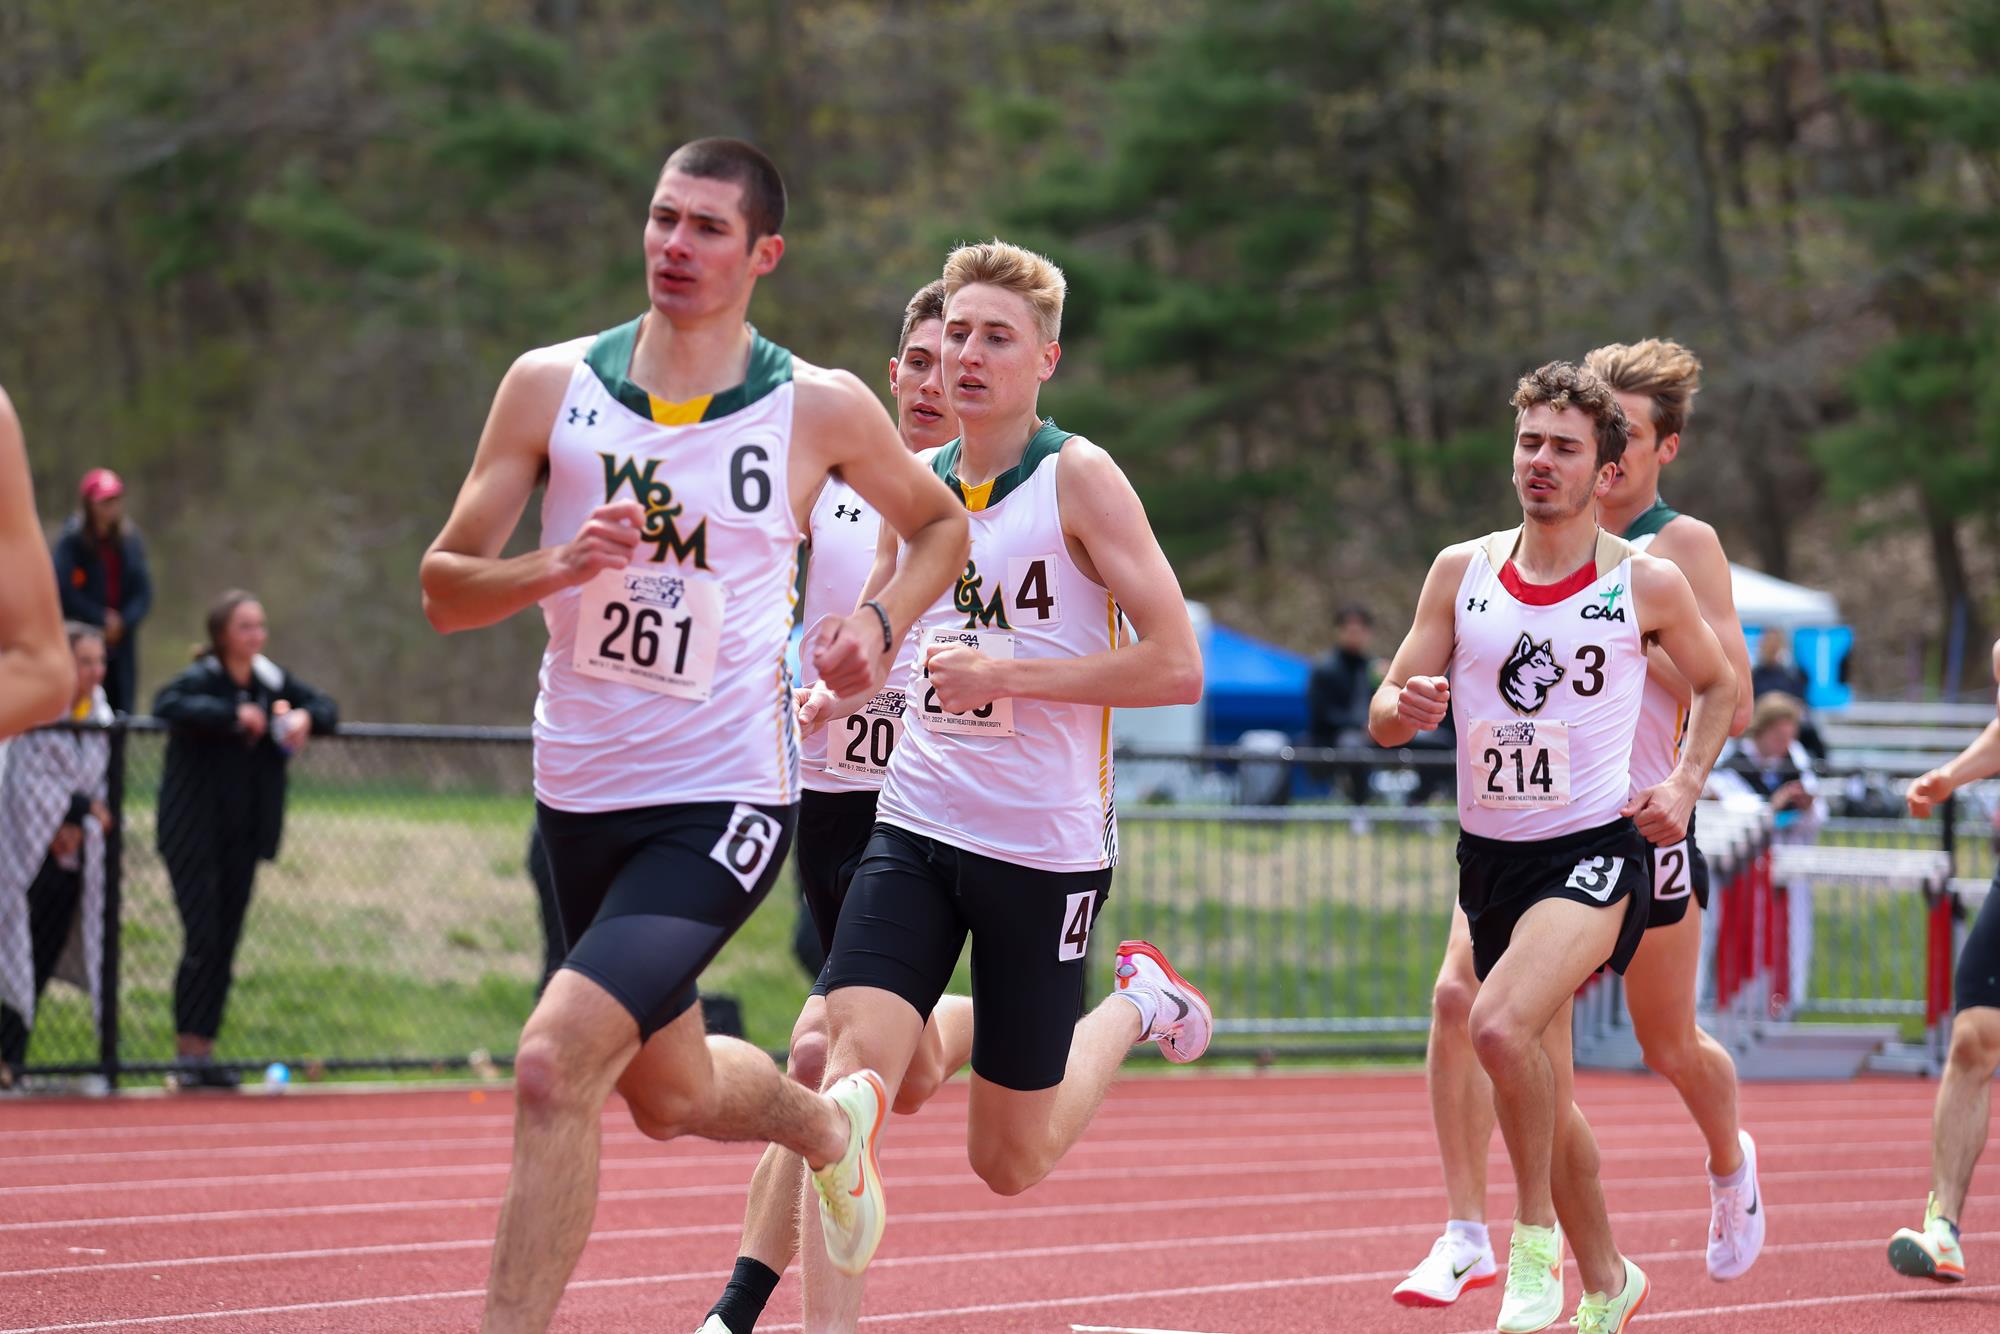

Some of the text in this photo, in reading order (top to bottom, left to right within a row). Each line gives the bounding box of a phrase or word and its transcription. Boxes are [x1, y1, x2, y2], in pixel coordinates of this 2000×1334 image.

[730, 444, 771, 513] 6
[953, 557, 1016, 631] &M
[1016, 560, 1055, 620] 4
[1580, 604, 1626, 623] CAA
[599, 601, 692, 675] 261
[959, 633, 978, 643] CAA
[1572, 644, 1606, 697] 3
[867, 703, 901, 714] FIELD
[869, 697, 897, 707] RACK
[886, 691, 906, 700] CAA
[846, 714, 894, 767] 20
[1492, 726, 1525, 737] TRACK
[1515, 721, 1534, 729] CAA
[870, 768, 886, 776] NORTHE
[1483, 747, 1553, 793] 214
[726, 813, 771, 875] 6
[1575, 856, 1614, 892] 3
[1660, 849, 1685, 895] 2
[1064, 895, 1090, 954] 4
